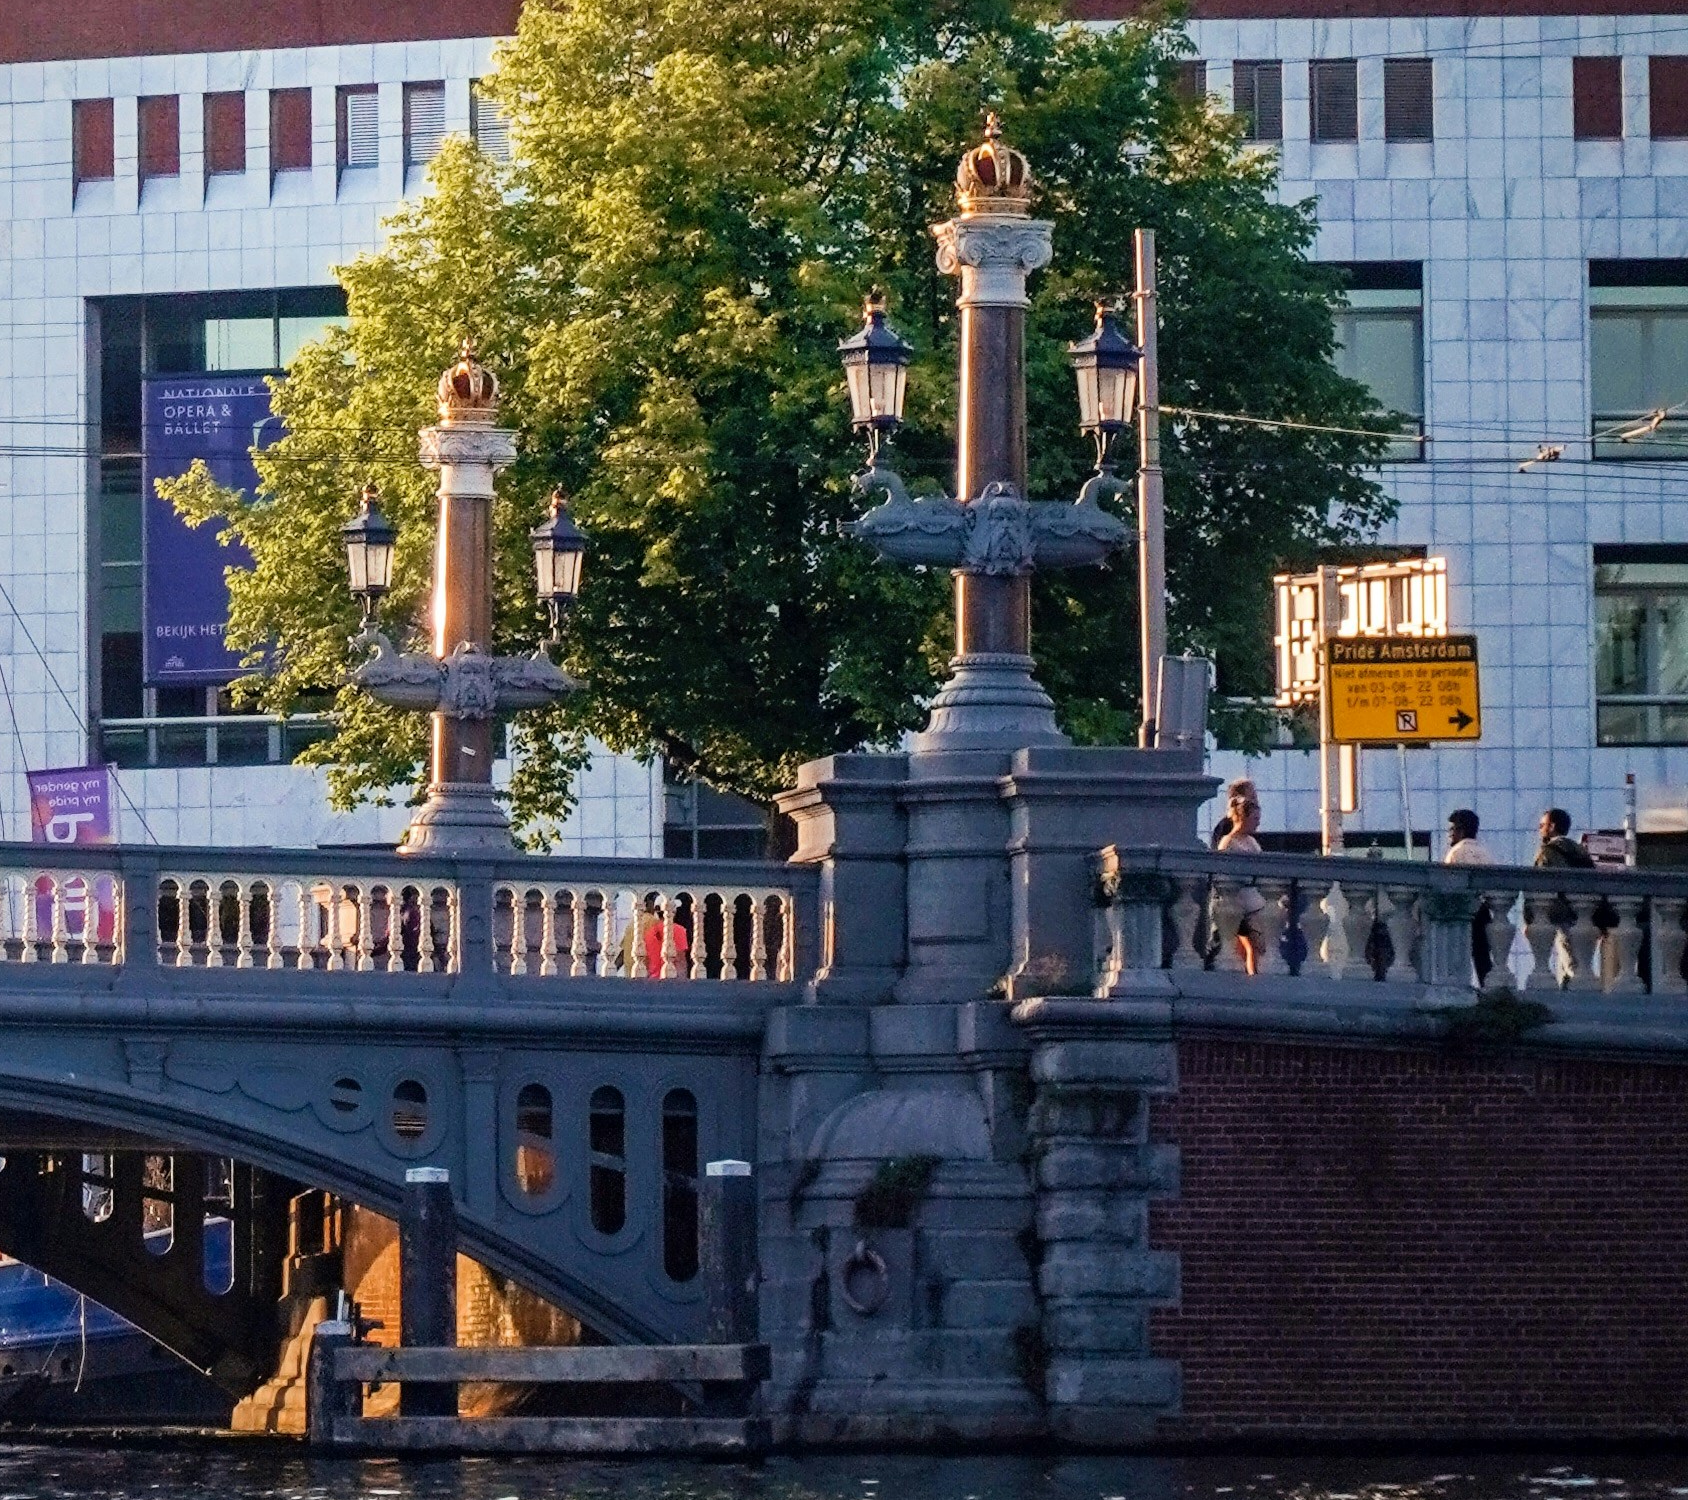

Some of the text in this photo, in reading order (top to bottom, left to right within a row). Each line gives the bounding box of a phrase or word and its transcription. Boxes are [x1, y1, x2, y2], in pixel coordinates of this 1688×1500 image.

[164, 403, 232, 419] OPERA &
[164, 420, 221, 435] BALLET
[156, 622, 226, 639] BEKIJK HET
[1334, 641, 1472, 659] Pride Amsterdam
